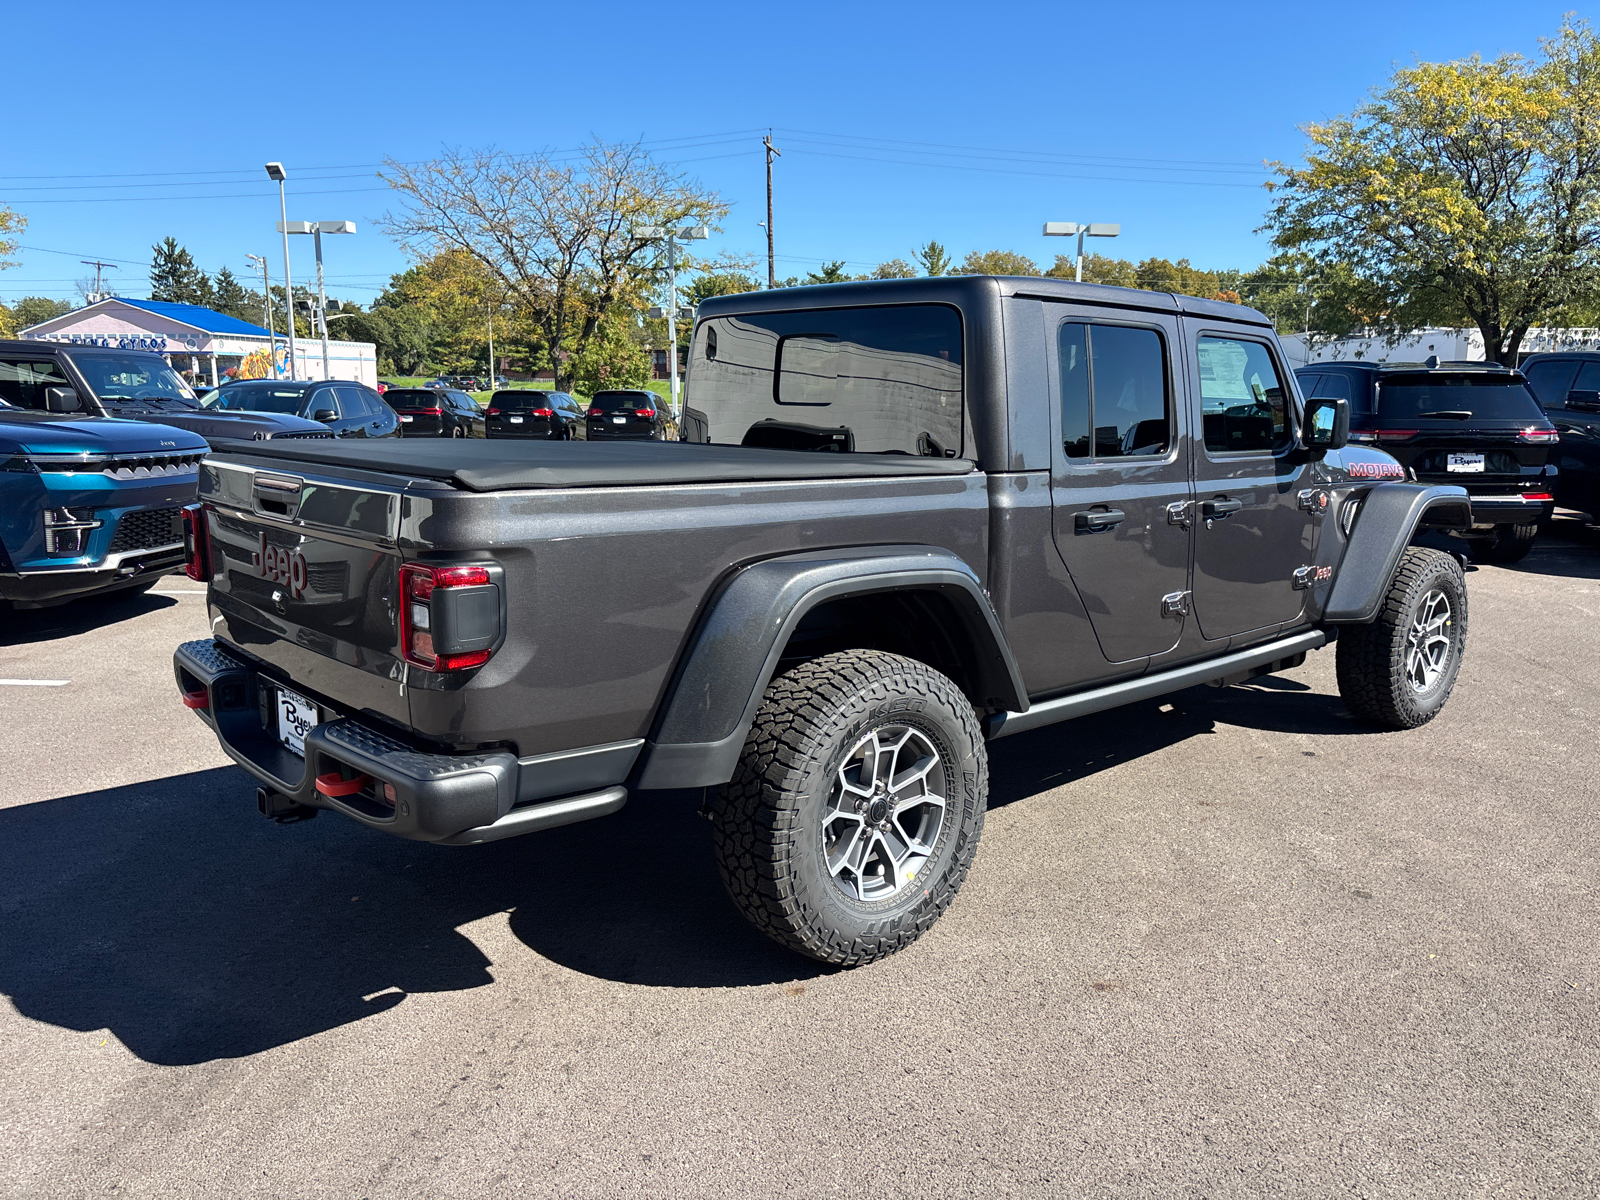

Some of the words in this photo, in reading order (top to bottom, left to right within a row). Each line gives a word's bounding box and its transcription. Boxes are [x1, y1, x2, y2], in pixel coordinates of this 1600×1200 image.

[119, 338, 167, 349] GYROS
[1349, 462, 1405, 479] MOJAVE
[251, 531, 308, 600] Jeep
[1314, 565, 1332, 581] Jeep
